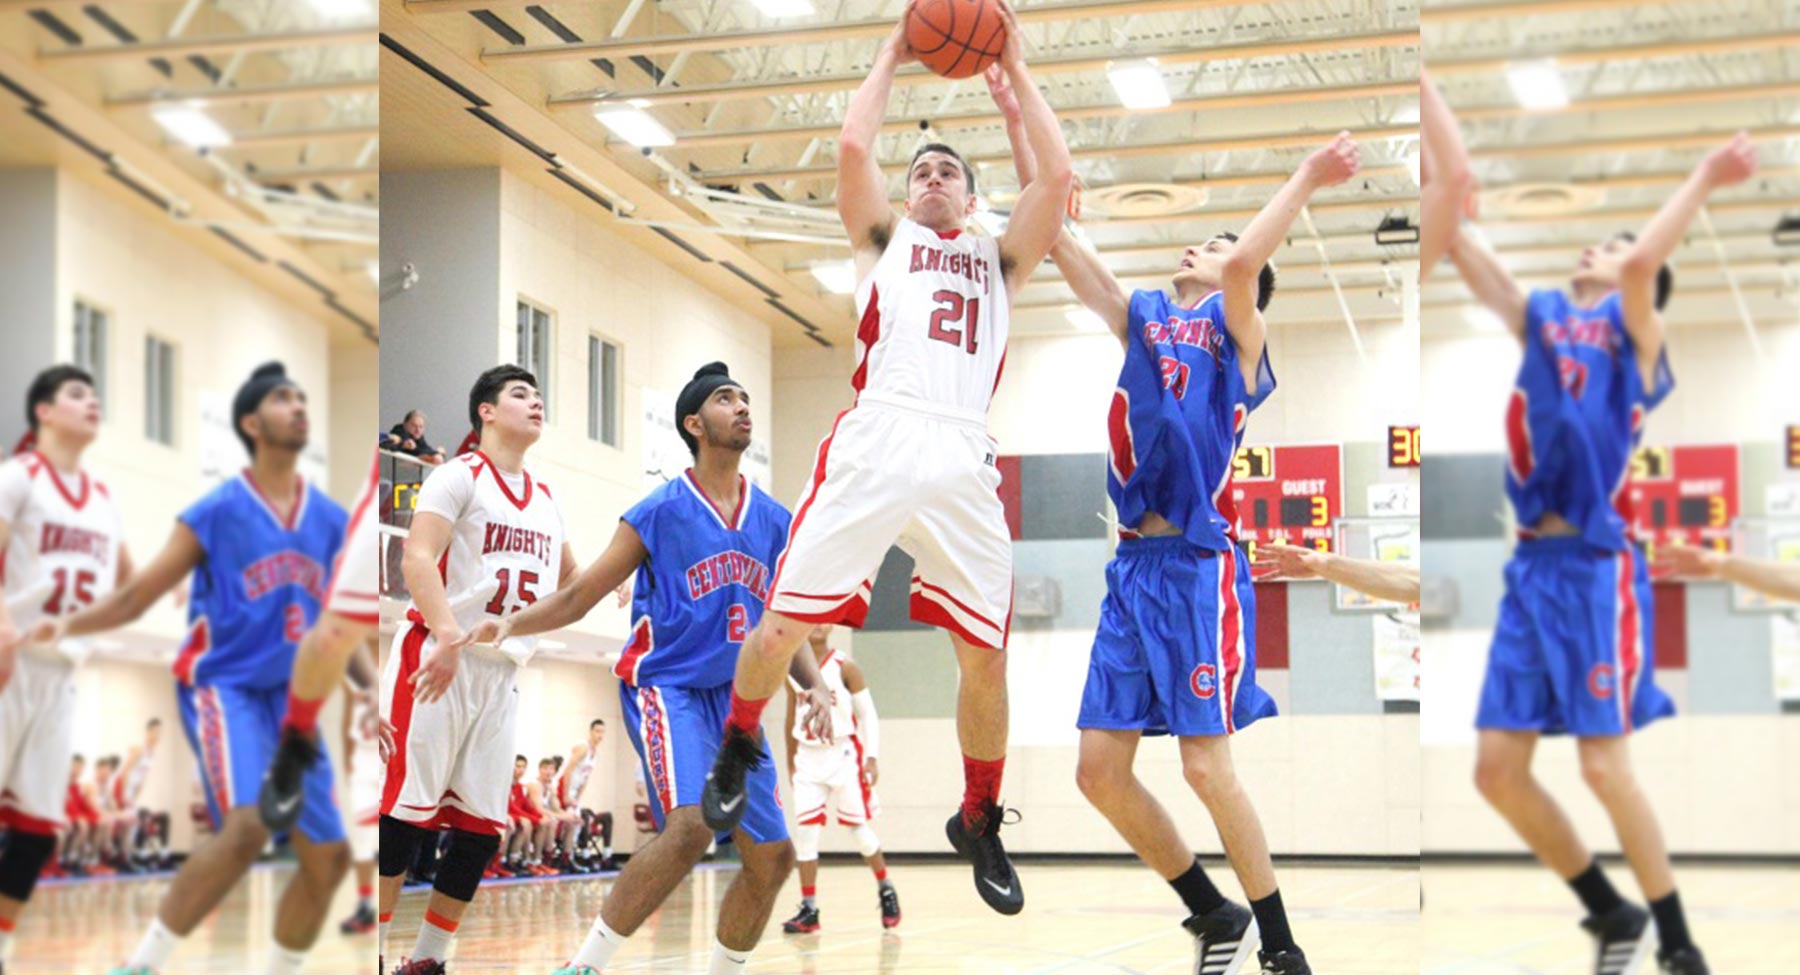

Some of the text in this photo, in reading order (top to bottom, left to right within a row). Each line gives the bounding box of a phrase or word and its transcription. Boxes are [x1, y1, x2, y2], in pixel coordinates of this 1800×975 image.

[928, 289, 979, 354] 21
[1232, 447, 1271, 478] 57
[1281, 479, 1327, 495] GUEST
[1311, 496, 1328, 526] 3
[482, 521, 552, 567] KNIGHTS
[485, 567, 539, 616] 15
[686, 550, 769, 602] CENTENIAL
